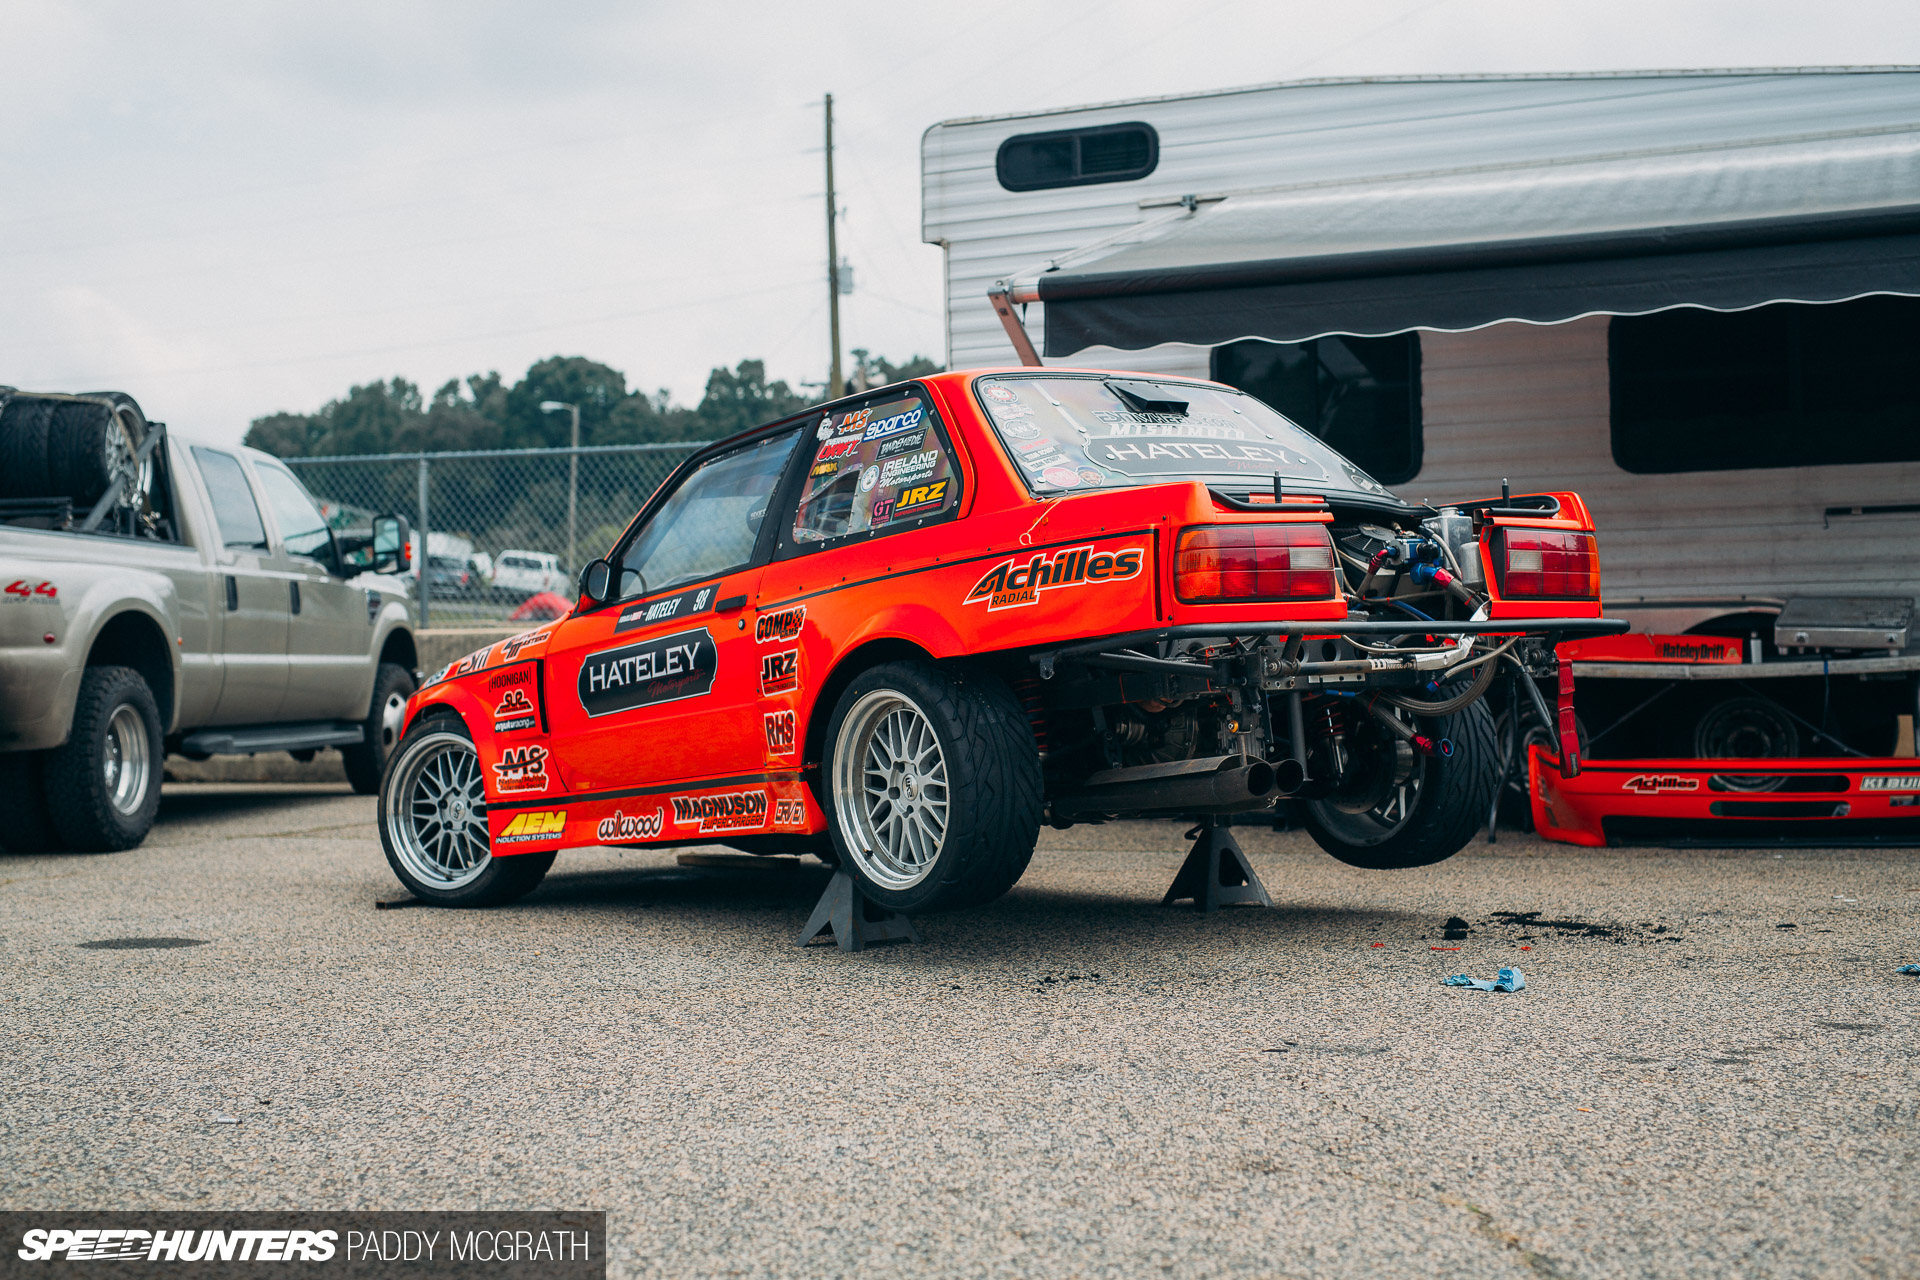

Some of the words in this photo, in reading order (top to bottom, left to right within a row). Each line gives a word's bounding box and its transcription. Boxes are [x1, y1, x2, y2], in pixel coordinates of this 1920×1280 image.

[866, 410, 923, 440] sparco
[1109, 423, 1245, 440] MISHIMOTO
[883, 450, 939, 472] IRELAND
[1105, 443, 1291, 464] HATELEY
[879, 470, 933, 488] Motorsports
[881, 461, 937, 480] ENGINEERING
[896, 481, 947, 508] JRZ
[874, 499, 894, 517] GT
[970, 550, 1139, 598] Achilles
[645, 597, 682, 621] HATELEY
[692, 588, 711, 612] 98
[991, 590, 1035, 606] RADIAL
[757, 611, 793, 639] COMP
[779, 627, 798, 639] CAMS
[589, 641, 701, 693] HATELEY
[762, 652, 797, 681] JRZ
[766, 712, 794, 747] RHS
[495, 747, 547, 777] MS
[1626, 776, 1698, 790] Achilles
[675, 792, 766, 821] MAGNUSON
[499, 811, 567, 837] AEM
[599, 807, 663, 838] wilwood
[701, 814, 764, 831] SUPERCHARGERS
[495, 834, 530, 844] INDUCTION
[531, 832, 562, 841] SYSTEMS
